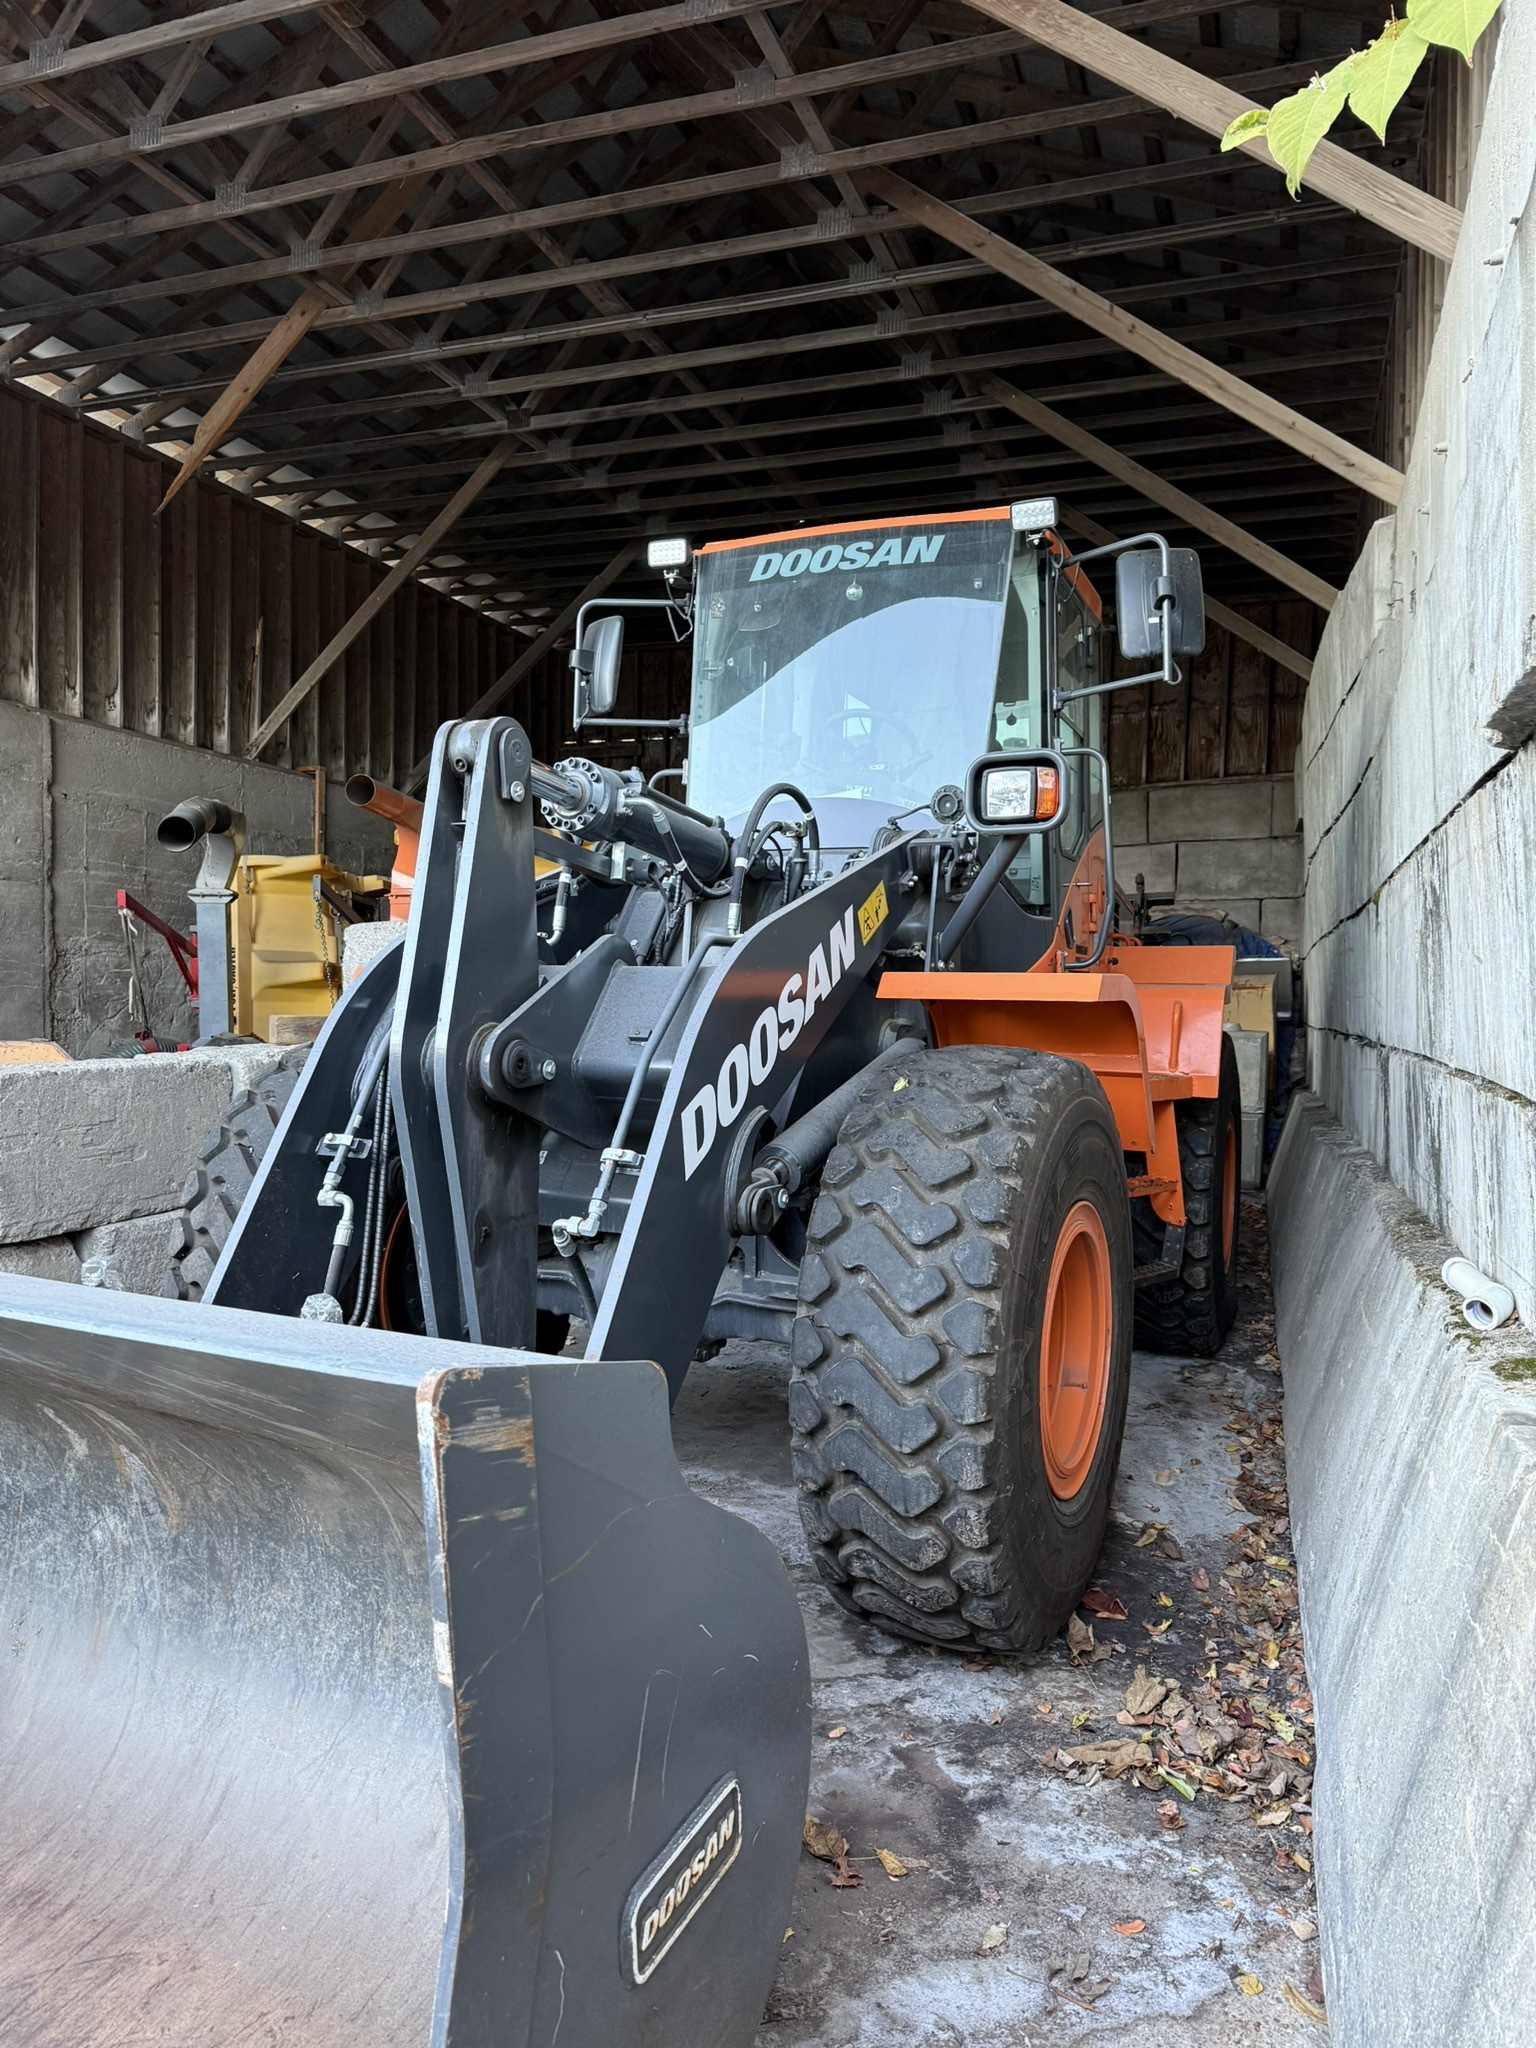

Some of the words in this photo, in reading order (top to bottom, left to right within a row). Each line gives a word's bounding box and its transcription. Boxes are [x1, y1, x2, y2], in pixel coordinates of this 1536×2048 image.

[749, 535, 945, 582] DOOSAN
[681, 904, 855, 1182] DOOSAN
[641, 1808, 735, 1951] DOOSAN
